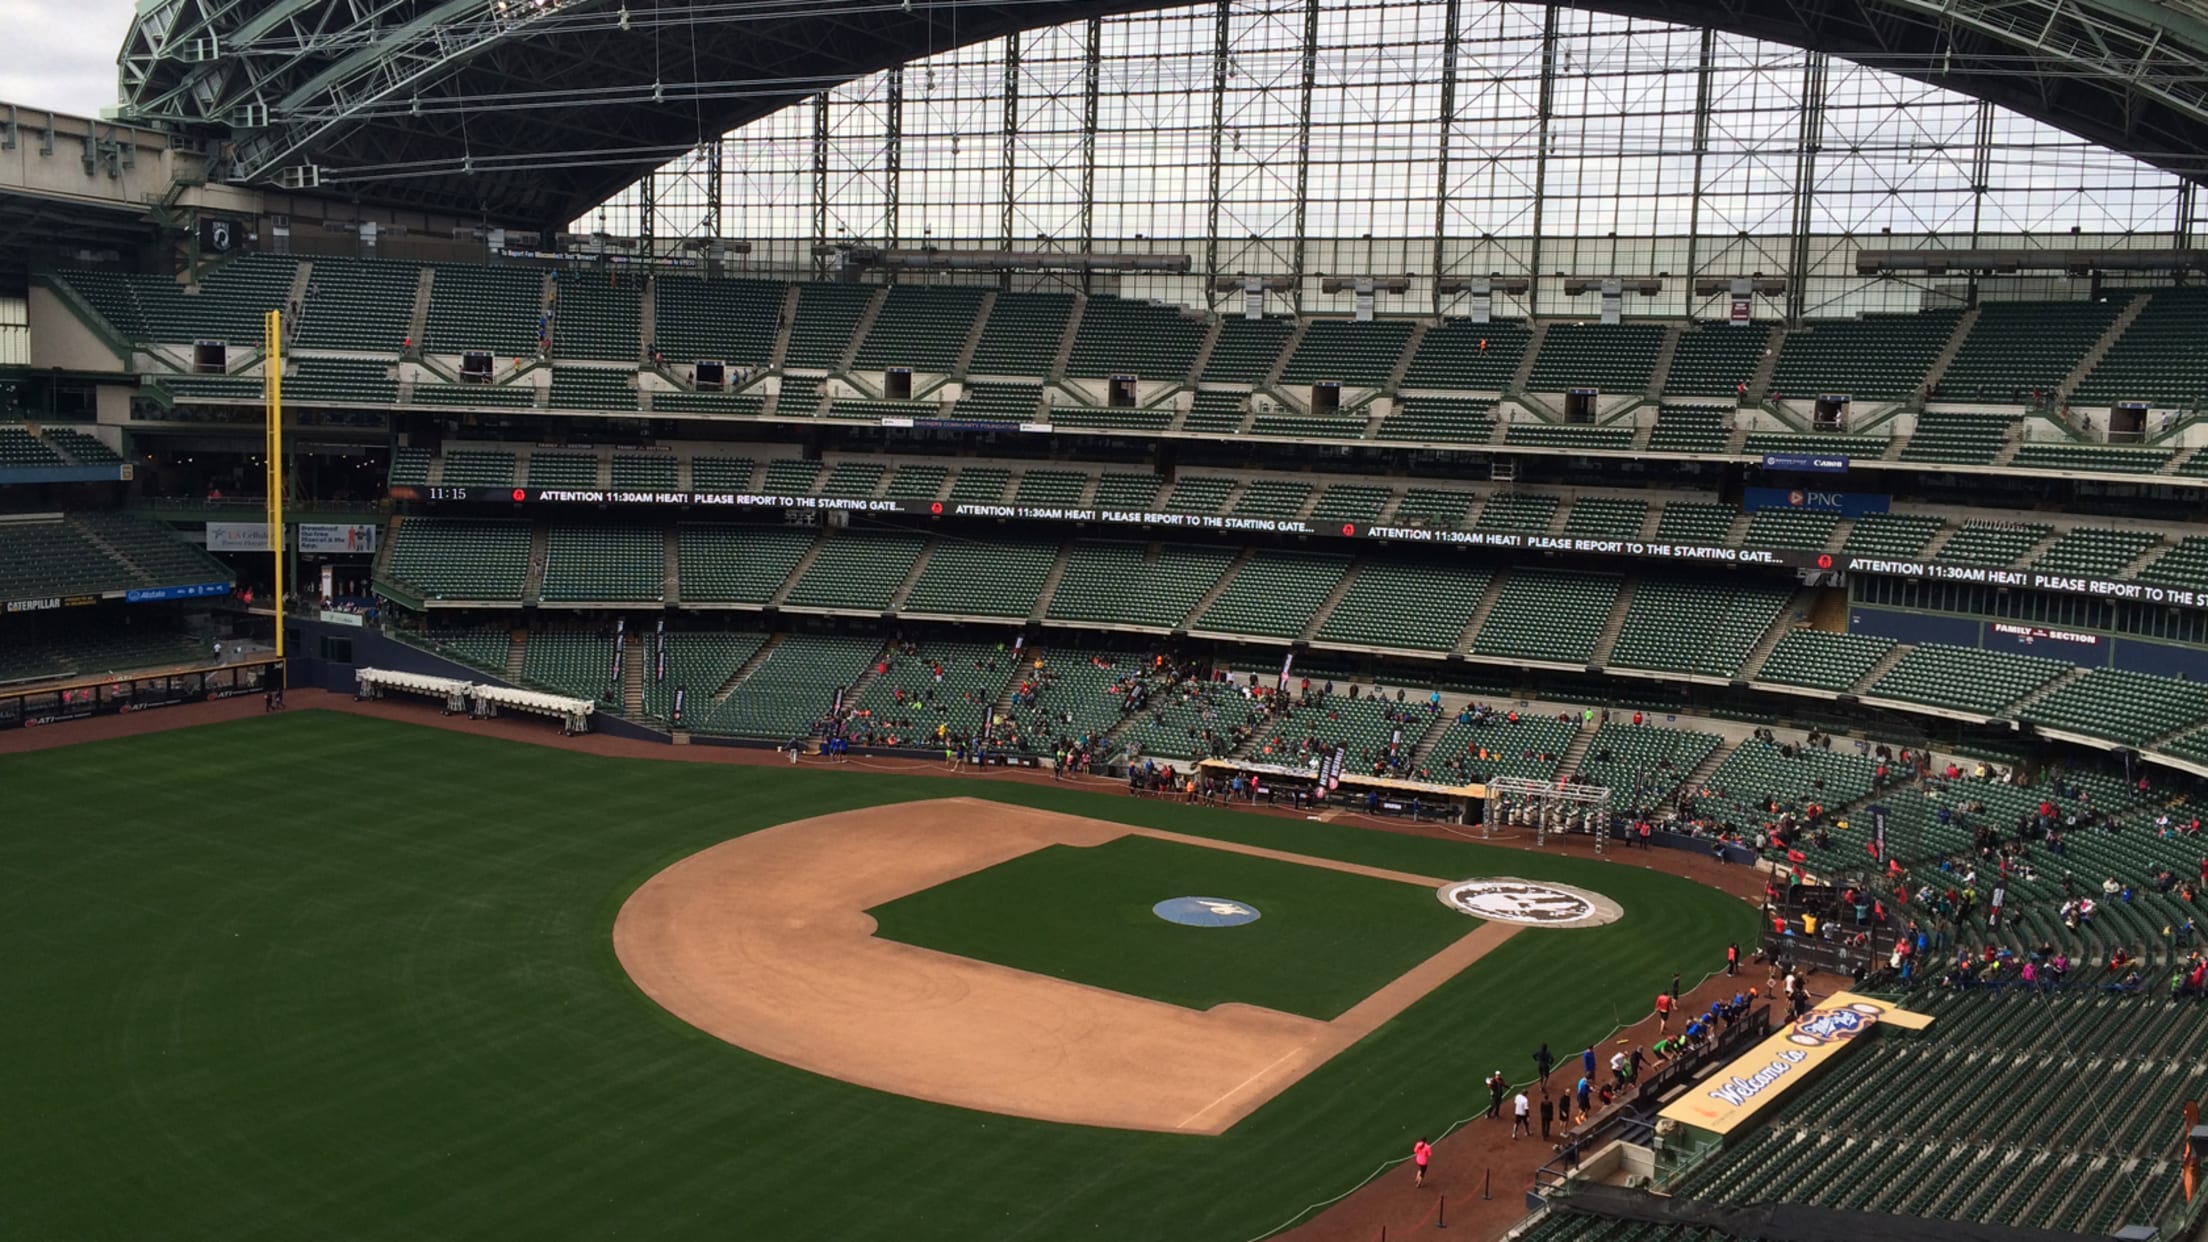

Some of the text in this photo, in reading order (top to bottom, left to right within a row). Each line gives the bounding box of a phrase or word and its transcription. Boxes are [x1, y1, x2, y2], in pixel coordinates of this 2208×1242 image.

[1814, 459, 1842, 468] Canon
[430, 488, 466, 500] 11:15
[540, 491, 905, 512] ATTENTION 11:30AM HEAT! PLEASE REPORT TO THE STARTING GATE...
[1808, 492, 1843, 507] PNC
[956, 505, 1314, 533] ATTENTION 11:30AM HEAT! PLEASE REPORT TO THE STARTING GATE...
[1368, 527, 1784, 564] ATTENTION 11:30AM HEAT! PLEASE REPORT TO THE STARTING GATE...
[1849, 558, 1924, 576] ATTENTION
[1927, 565, 1985, 582] 11:30AM
[1988, 570, 2028, 586] HEAT!
[2035, 575, 2086, 592] PLEASE
[2090, 581, 2142, 598] REPORT
[2144, 587, 2164, 600] TO
[2167, 590, 2193, 605] THE
[7, 598, 60, 612] CATERPILLAR
[1994, 624, 2032, 635] FAMILY
[2049, 630, 2096, 644] SECTION
[217, 690, 232, 698] ATI
[131, 703, 148, 712] ATI
[36, 716, 55, 724] ATI
[1708, 1050, 1808, 1107] Welcome to
